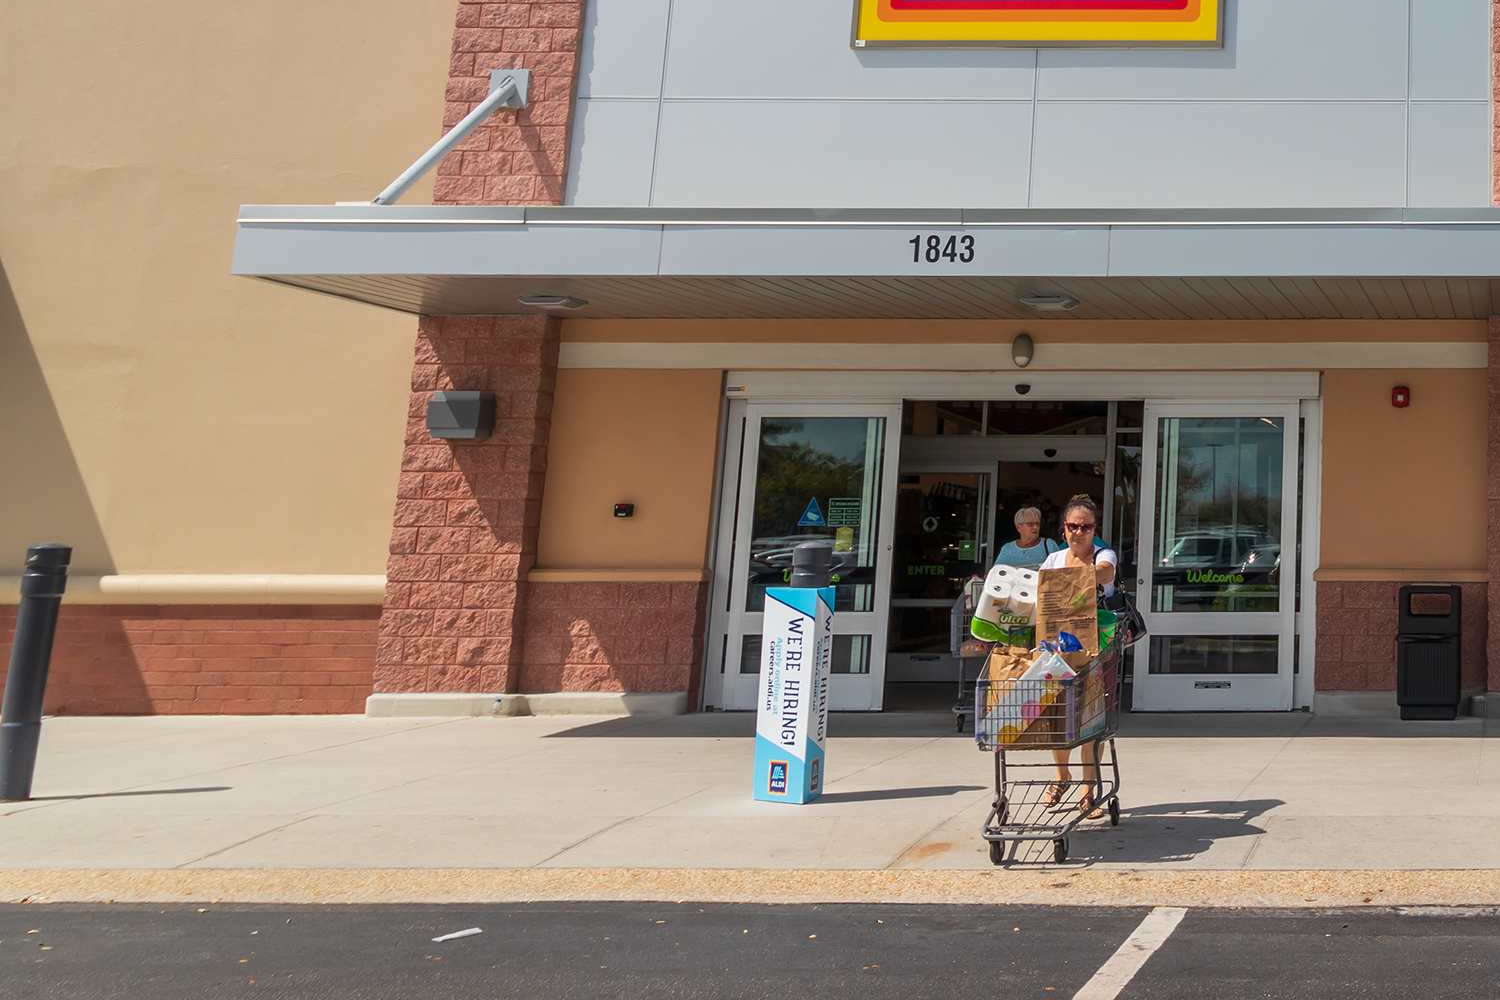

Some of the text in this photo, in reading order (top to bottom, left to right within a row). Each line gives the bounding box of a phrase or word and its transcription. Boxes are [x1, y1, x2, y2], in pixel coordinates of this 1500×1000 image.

[909, 234, 975, 263] 1843
[907, 564, 945, 575] ENTER
[1186, 569, 1244, 584] Welcome
[999, 614, 1031, 625] Ultra
[766, 641, 775, 711] careers.aldi.us
[781, 617, 804, 746] WE'RE HIRING!
